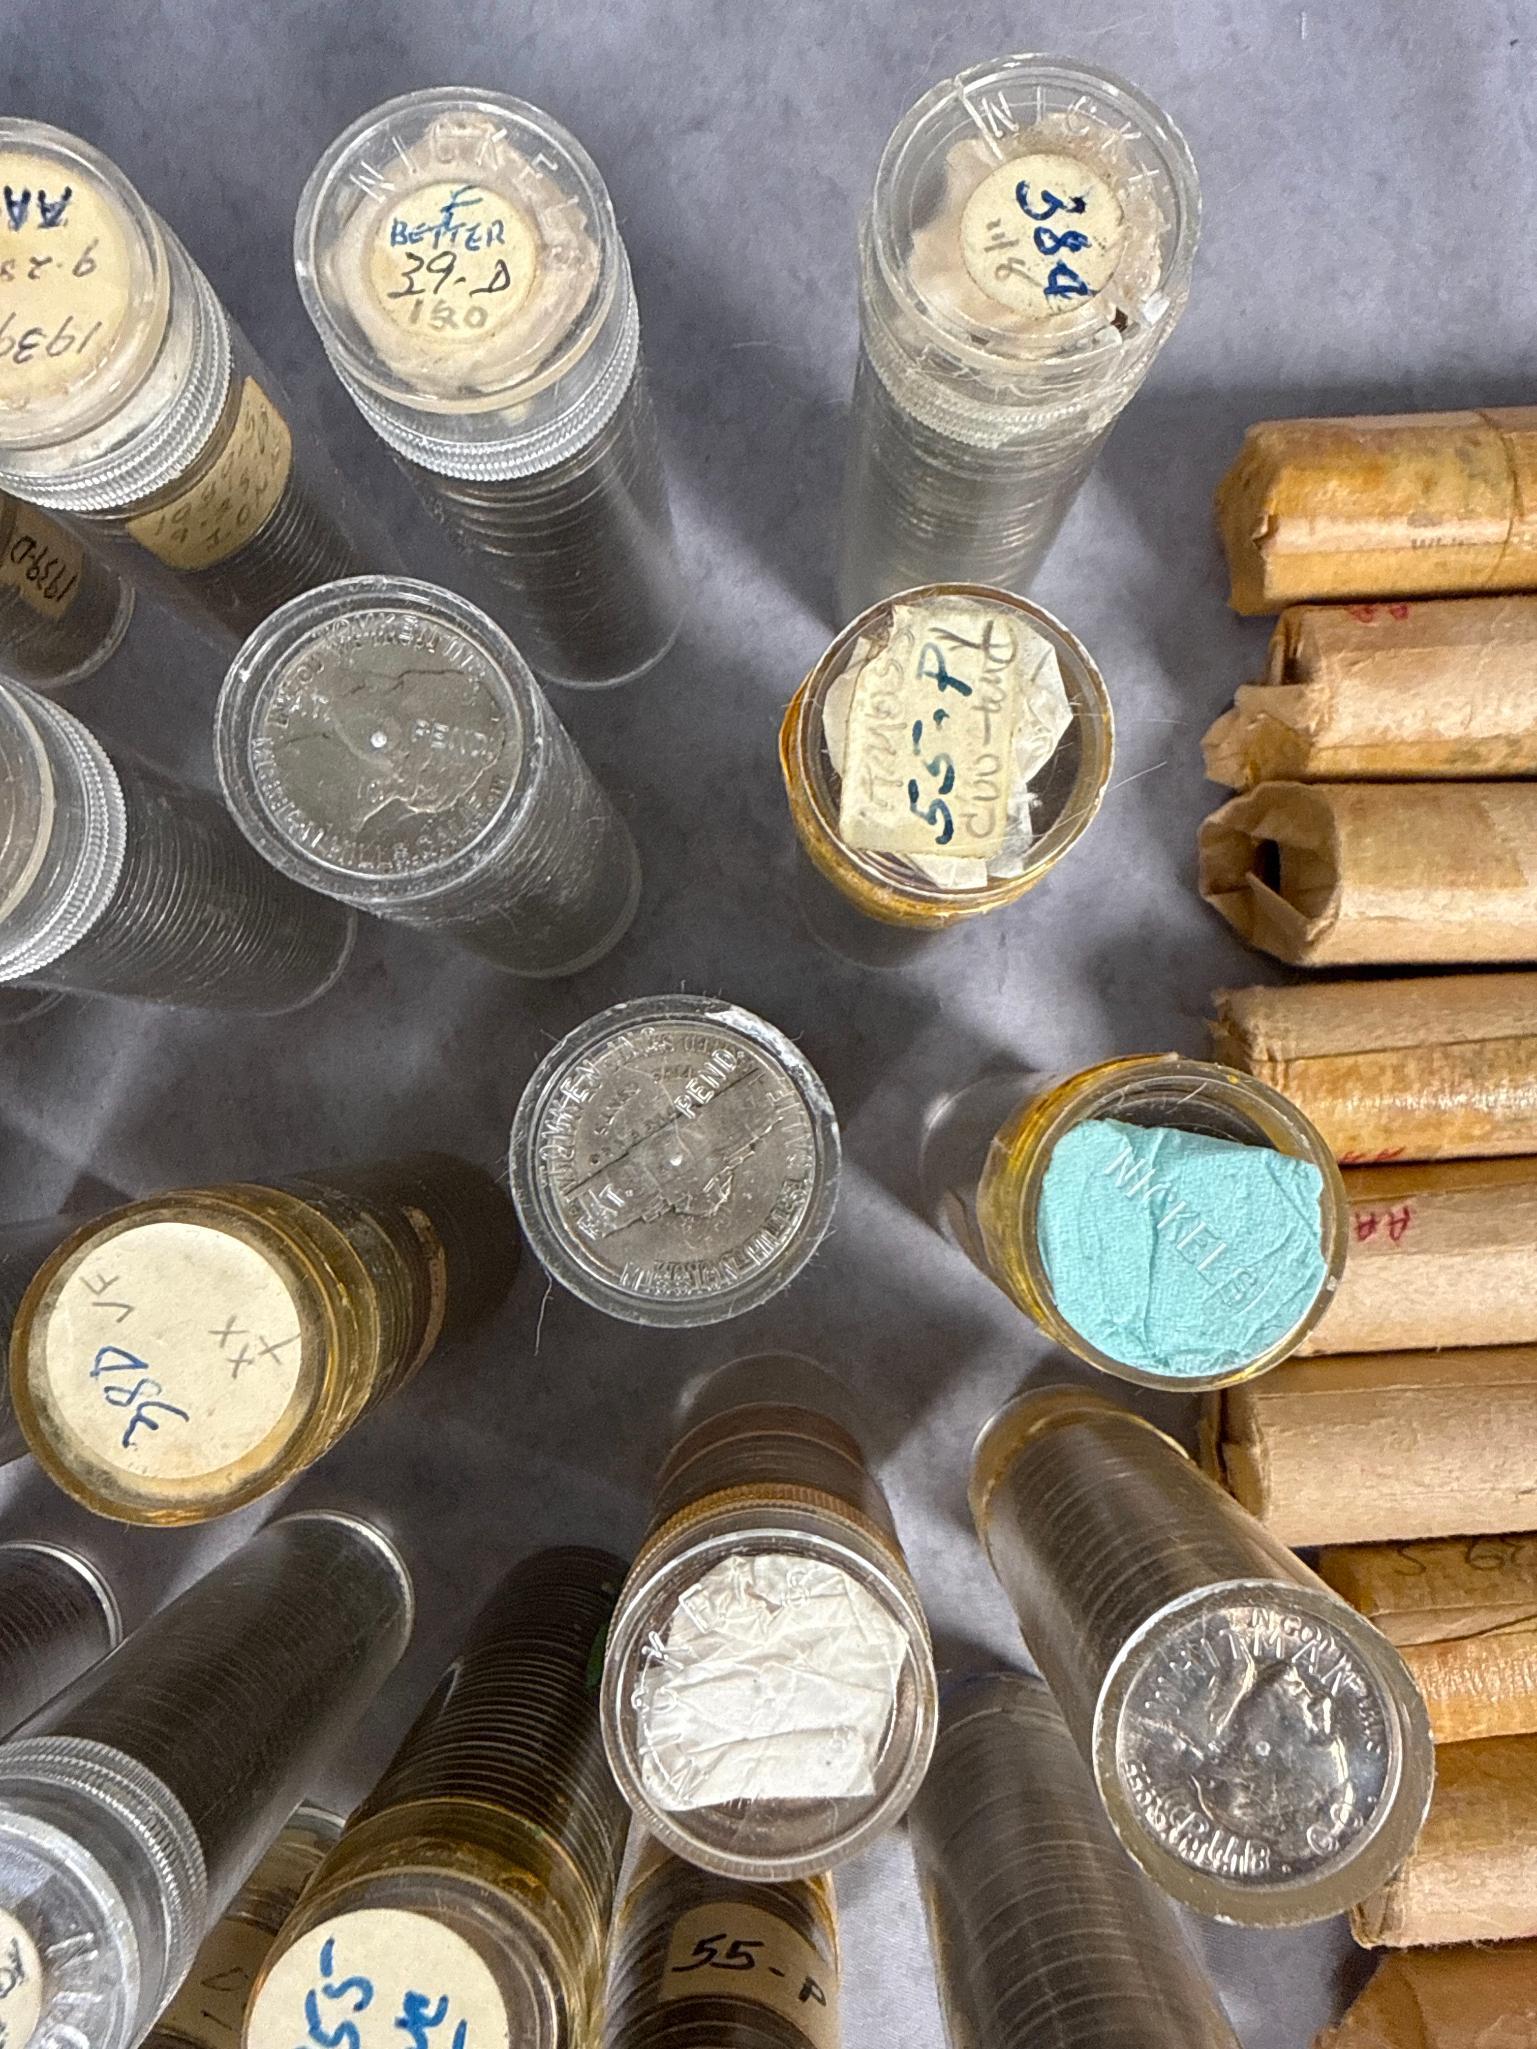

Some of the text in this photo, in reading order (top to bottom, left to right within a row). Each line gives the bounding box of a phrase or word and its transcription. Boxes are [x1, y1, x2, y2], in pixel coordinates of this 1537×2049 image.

[391, 218, 505, 252] BETTER
[1103, 1145, 1258, 1308] NICKELS
[671, 1933, 828, 2007] 55-P
